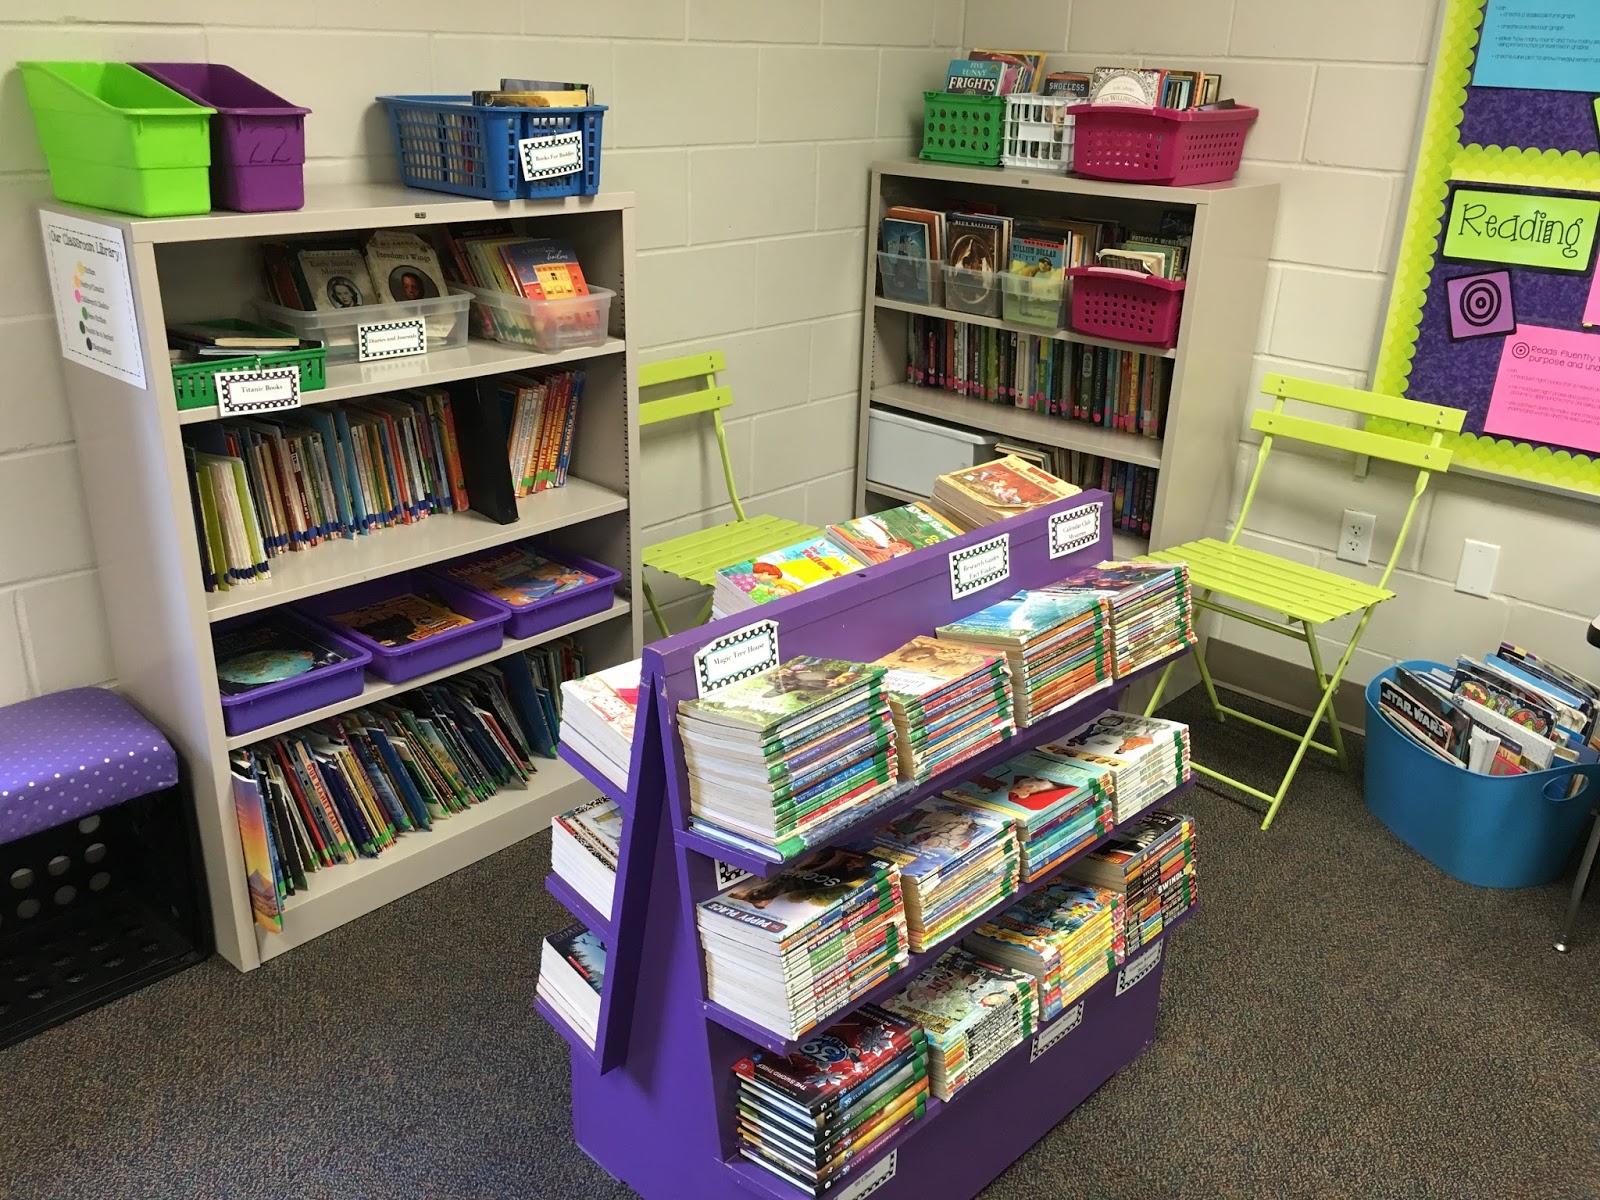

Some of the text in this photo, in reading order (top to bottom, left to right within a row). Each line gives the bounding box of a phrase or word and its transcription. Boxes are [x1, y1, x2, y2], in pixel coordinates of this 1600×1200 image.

[962, 69, 987, 77] FUNNY
[948, 76, 996, 92] FRIGHTS
[1049, 82, 1085, 92] SHOELESS
[559, 151, 575, 159] Buddies
[1458, 203, 1584, 259] Reading
[63, 232, 95, 253] Classroom
[95, 241, 119, 262] Library
[376, 251, 431, 262] Freedom's Wings
[1531, 345, 1558, 356] Reads
[1528, 355, 1565, 367] purpose
[1567, 361, 1583, 369] and
[1063, 519, 1091, 533] Calendar Club
[1069, 531, 1087, 540] Mysteries
[447, 550, 520, 577] Highlights
[801, 549, 833, 571] Yellow
[963, 554, 999, 572] Research Guides
[969, 565, 997, 579] Fact Finders
[713, 643, 764, 665] Magic Tree House
[1382, 689, 1444, 737] STAR WARS
[307, 764, 341, 834] OUR PLANET EARTH
[1143, 862, 1158, 877] TITANIC
[1143, 870, 1159, 885] TITANIC
[1158, 870, 1184, 894] SWINDL
[1143, 881, 1159, 894] TITANIC
[706, 902, 736, 919] PLACE
[737, 911, 773, 930] PUPPY
[800, 1039, 841, 1062] 39
[756, 1064, 774, 1075] THIEF
[773, 1072, 796, 1086] SWORD
[794, 1082, 807, 1091] THE
